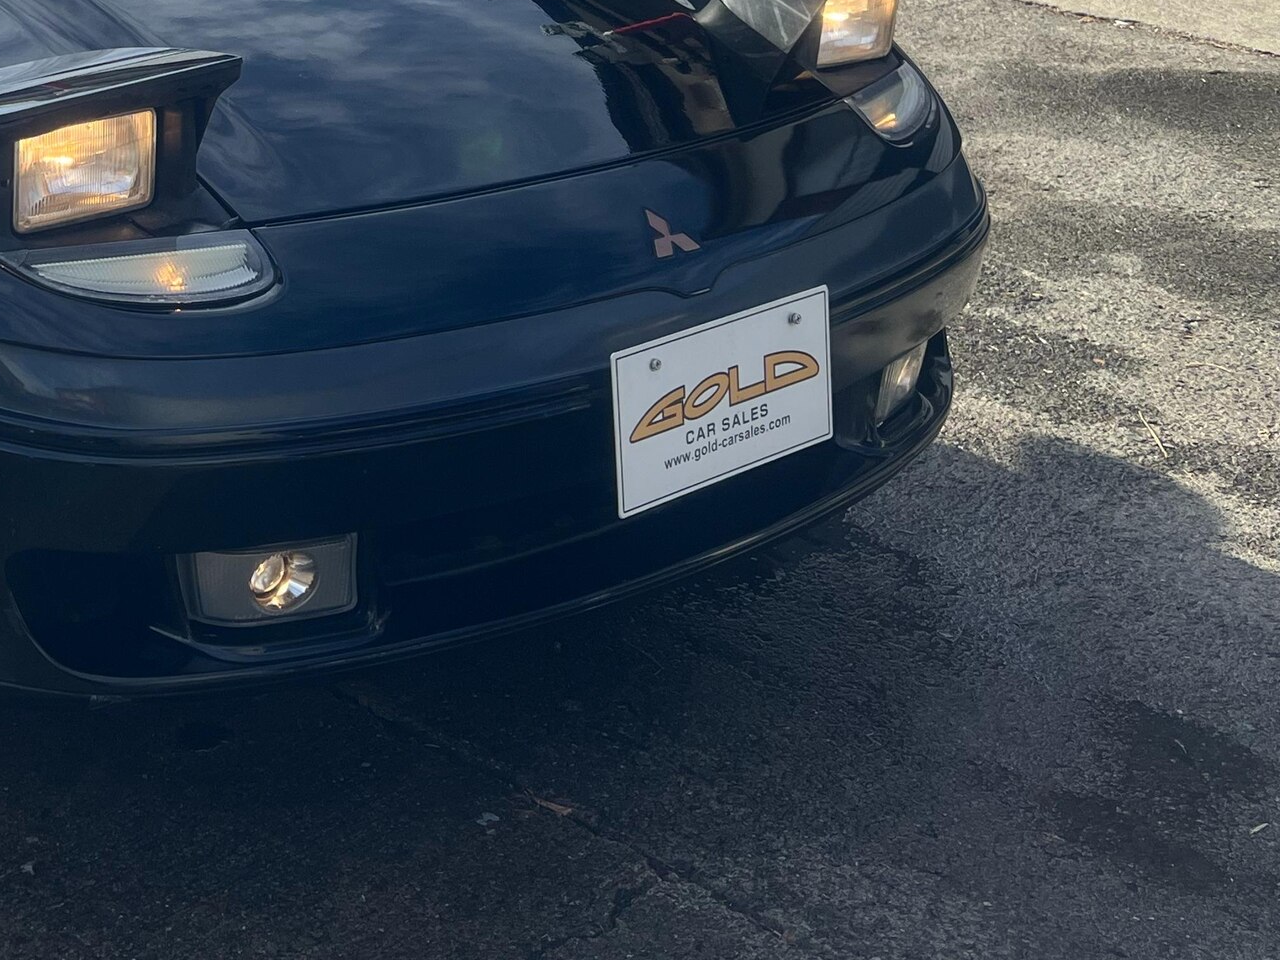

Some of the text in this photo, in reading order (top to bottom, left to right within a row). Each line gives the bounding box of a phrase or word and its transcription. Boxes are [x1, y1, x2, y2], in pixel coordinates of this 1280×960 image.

[629, 350, 820, 444] GOLD
[685, 403, 769, 445] CAR SALES
[664, 413, 791, 470] www.gold-carsales.com
